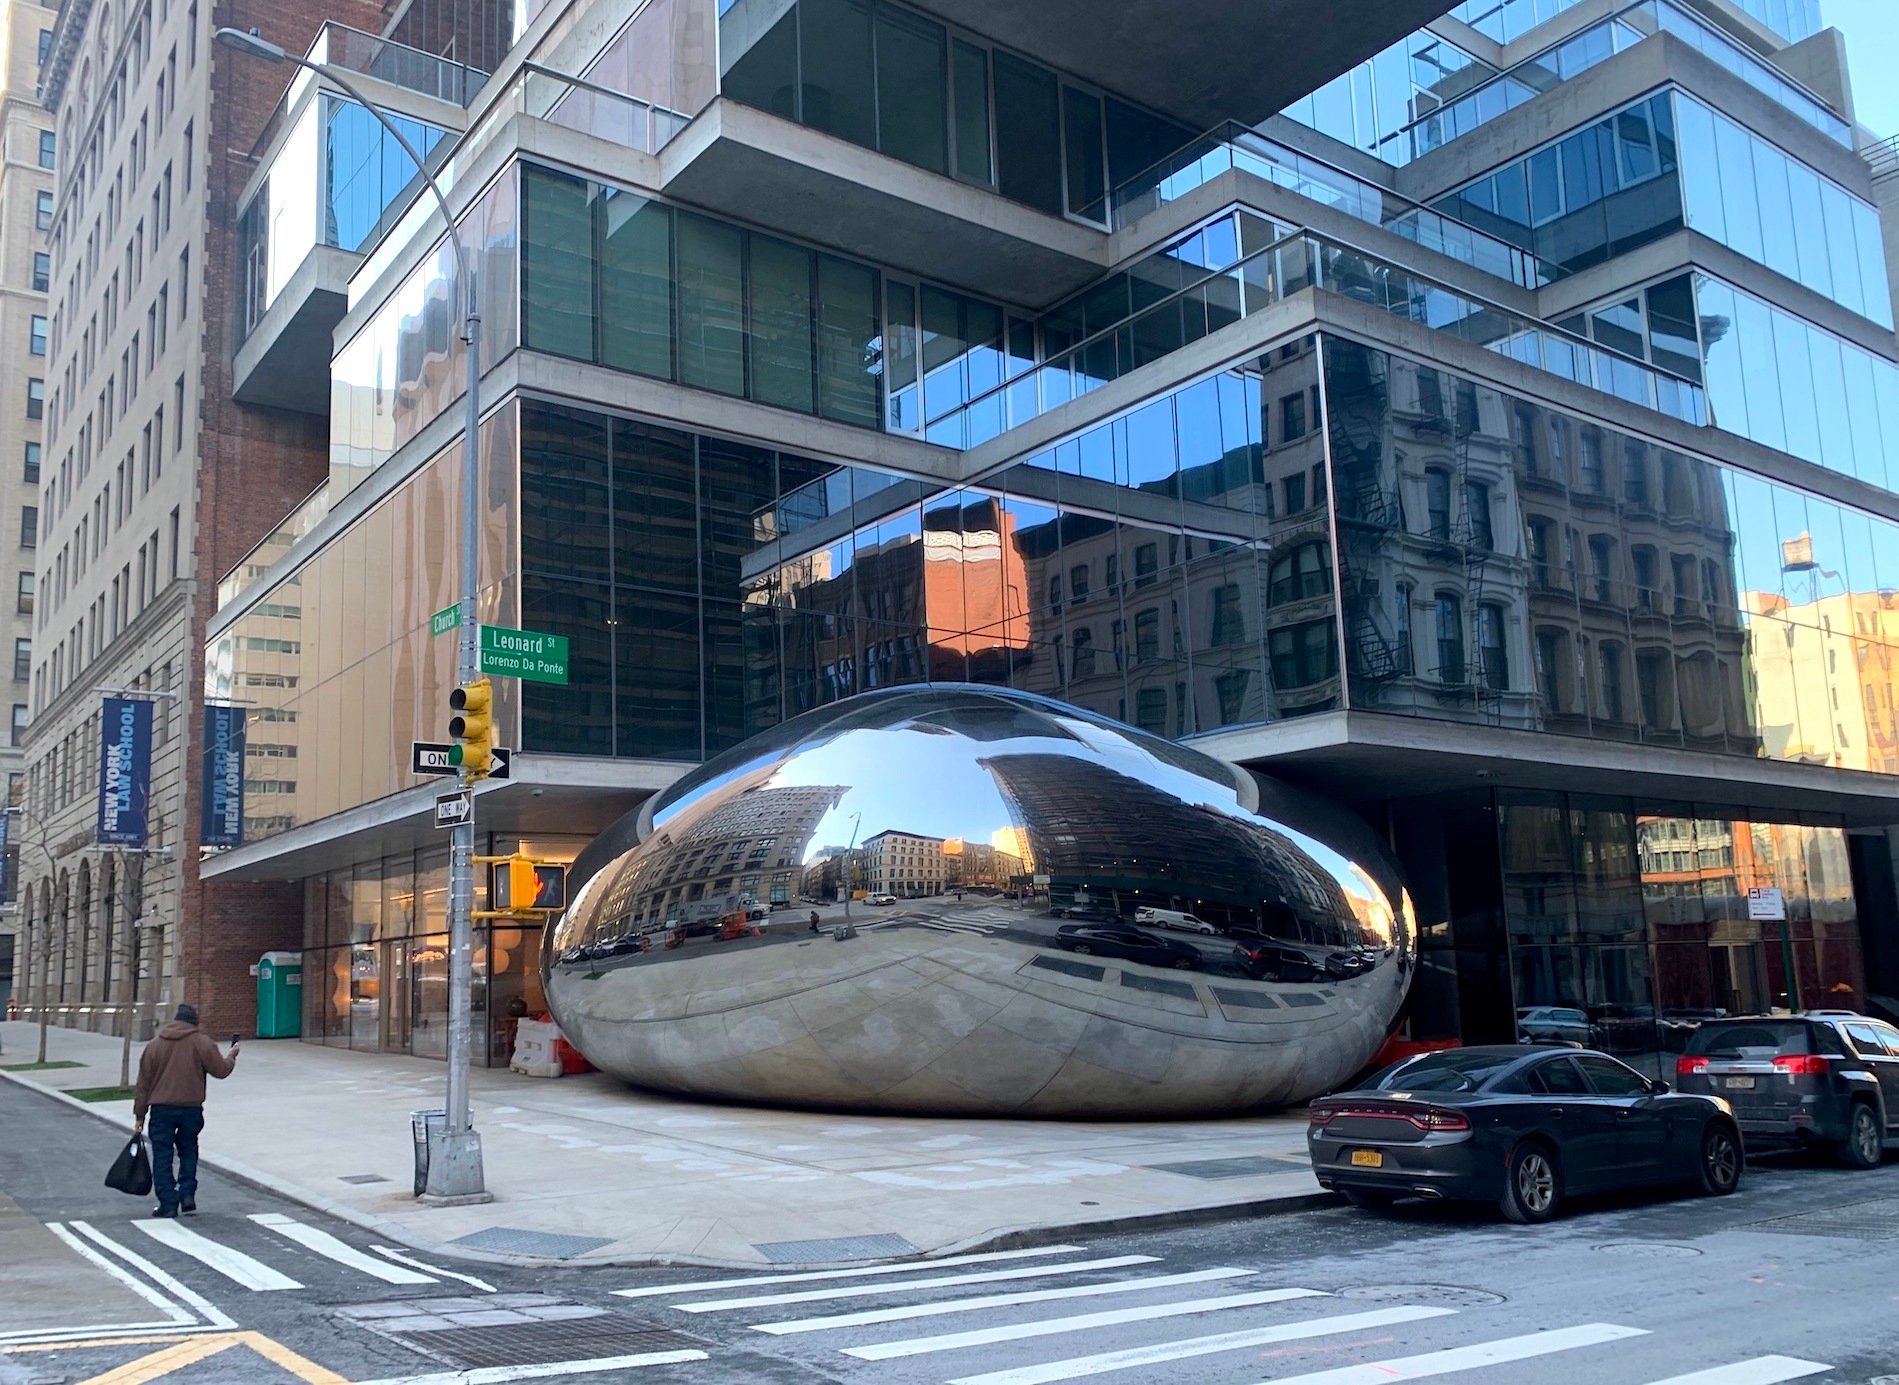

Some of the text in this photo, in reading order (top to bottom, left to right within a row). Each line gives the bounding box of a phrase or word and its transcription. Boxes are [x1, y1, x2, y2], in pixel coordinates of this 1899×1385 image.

[435, 610, 455, 632] Church
[493, 631, 555, 653] Leonard St
[483, 652, 564, 675] Lorenzo Da Ponte
[118, 704, 135, 812] LAW SCHOOL
[428, 753, 447, 766] ON
[103, 744, 120, 832] NEW YORK
[441, 800, 467, 817] ONE WAY
